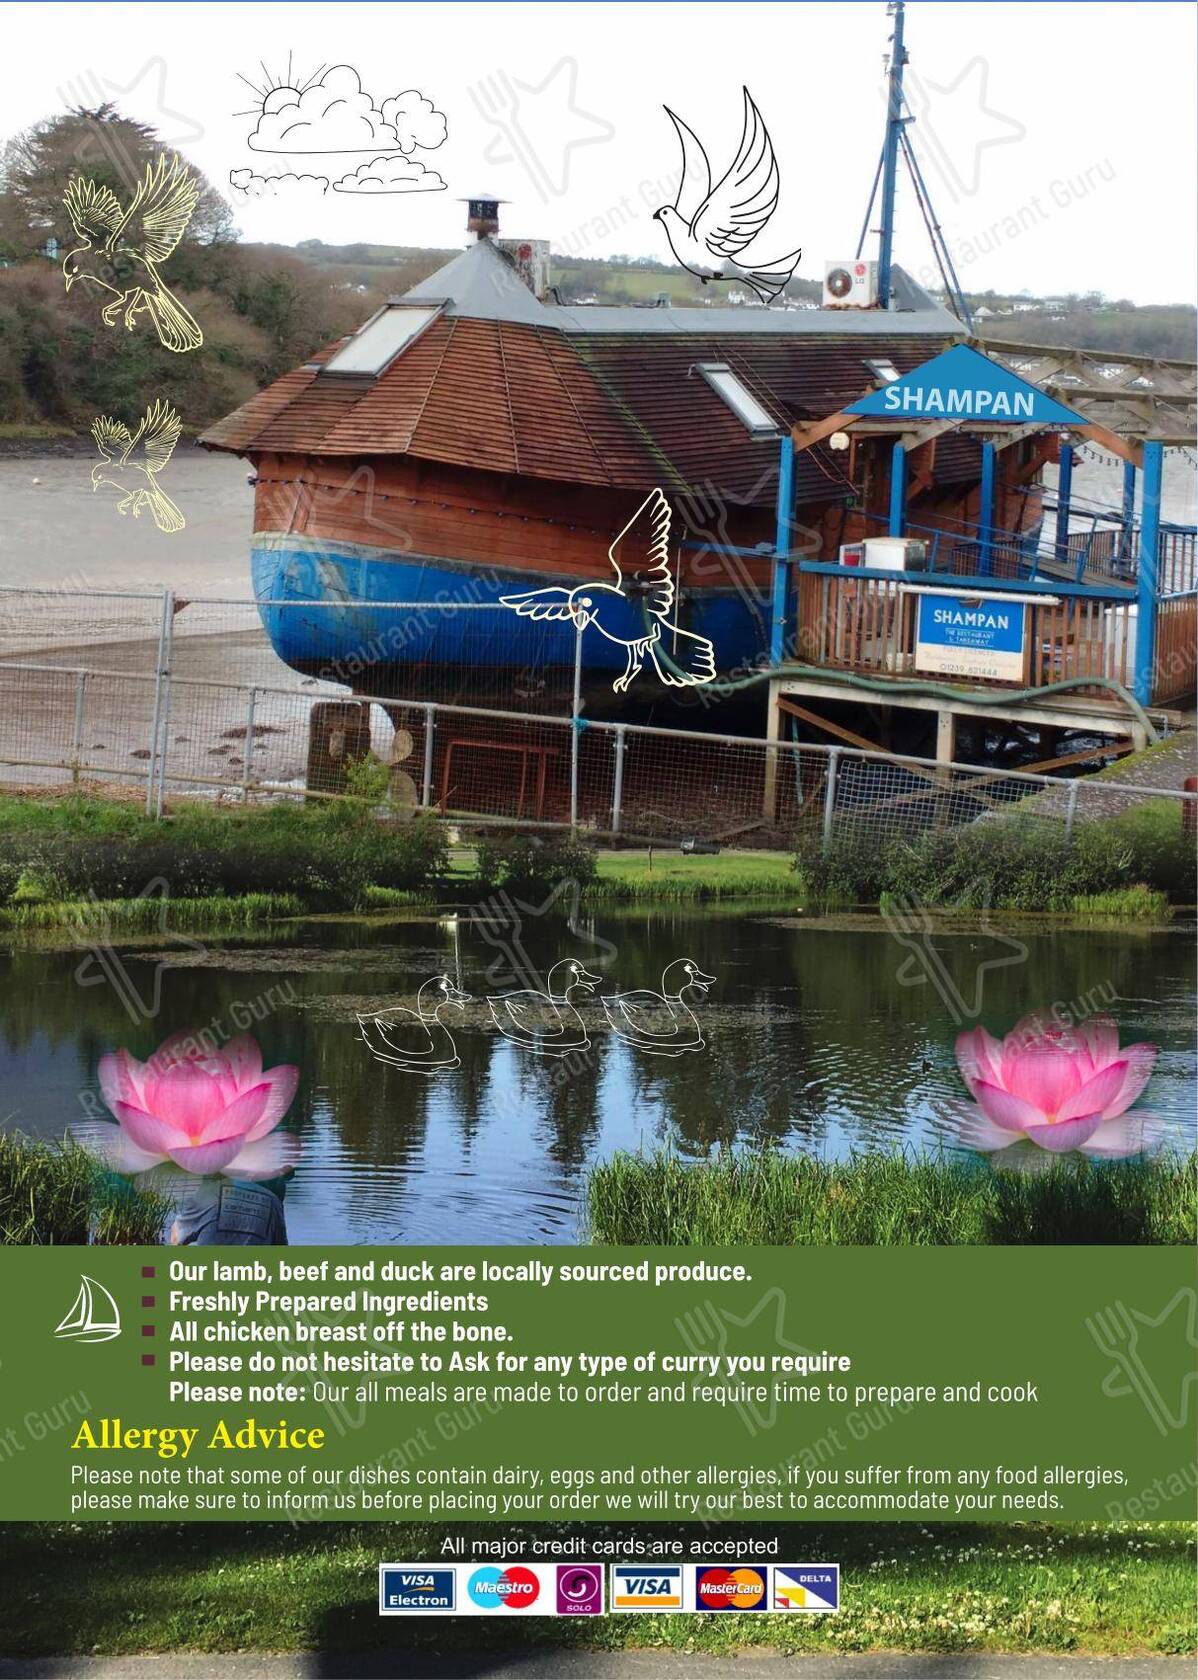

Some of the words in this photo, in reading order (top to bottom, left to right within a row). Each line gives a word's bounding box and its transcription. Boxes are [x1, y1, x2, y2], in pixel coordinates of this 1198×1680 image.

[885, 386, 1034, 417] SHAMPAN
[933, 609, 1009, 629] SHAMPAN
[169, 1260, 208, 1282] Our
[213, 1260, 273, 1284] lamb,
[279, 1260, 329, 1282] beef
[334, 1260, 375, 1281] and
[380, 1260, 435, 1281] duck
[440, 1265, 476, 1282] are
[482, 1260, 554, 1287] locally
[559, 1260, 649, 1282] sourced
[655, 1260, 752, 1286] produce.
[170, 1290, 250, 1317] Freshly
[256, 1290, 357, 1317] Prepared
[362, 1290, 489, 1317] Ingredients
[169, 1320, 198, 1342] All
[203, 1320, 290, 1342] chicken
[295, 1321, 367, 1342] breast
[373, 1320, 405, 1342] off
[410, 1321, 447, 1342] the
[452, 1321, 514, 1342] bone.
[170, 1351, 243, 1372] Please
[248, 1351, 276, 1372] do
[281, 1352, 318, 1372] not
[323, 1350, 415, 1372] hesitate
[420, 1352, 443, 1372] to
[448, 1351, 491, 1372] Ask
[495, 1351, 529, 1372] for
[533, 1356, 573, 1377] any
[578, 1352, 628, 1377] type
[633, 1351, 656, 1372] of
[662, 1356, 721, 1377] curry
[726, 1355, 765, 1377] you
[771, 1350, 851, 1377] require
[170, 1381, 243, 1402] Please
[249, 1382, 306, 1402] note:
[313, 1381, 350, 1402] Our
[355, 1381, 378, 1402] all
[385, 1381, 447, 1402] meals
[453, 1386, 487, 1402] are
[494, 1381, 551, 1402] made
[558, 1383, 579, 1402] to
[585, 1381, 642, 1402] order
[647, 1381, 685, 1402] and
[692, 1381, 767, 1407] require
[774, 1381, 821, 1402] time
[827, 1383, 848, 1402] to
[855, 1386, 936, 1407] prepare
[943, 1381, 981, 1402] and
[988, 1381, 1038, 1402] cook
[71, 1418, 199, 1459] Allergy
[207, 1418, 325, 1449] Advice
[71, 1465, 133, 1485] Please
[139, 1467, 181, 1485] note
[186, 1465, 225, 1485] that
[230, 1470, 282, 1485] some
[288, 1465, 307, 1485] of
[312, 1470, 344, 1485] our
[349, 1465, 410, 1485] dishes
[416, 1465, 487, 1485] contain
[492, 1465, 544, 1489] dairy,
[550, 1470, 595, 1489] eggs
[600, 1465, 634, 1484] and
[640, 1465, 692, 1485] other
[696, 1465, 781, 1489] allergies,
[788, 1465, 801, 1484] if
[805, 1470, 839, 1489] you
[844, 1465, 902, 1485] suffer
[906, 1465, 951, 1484] from
[957, 1470, 991, 1489] any
[995, 1465, 1037, 1485] food
[1043, 1465, 1128, 1489] allergies,
[71, 1490, 132, 1514] please
[138, 1490, 189, 1509] make
[195, 1494, 236, 1509] sure
[241, 1491, 261, 1509] to
[267, 1490, 328, 1509] inform
[334, 1494, 356, 1509] us
[362, 1489, 423, 1509] before
[429, 1490, 497, 1514] placing
[502, 1494, 544, 1514] your
[549, 1490, 601, 1509] order
[605, 1494, 632, 1509] we
[637, 1490, 668, 1509] will
[674, 1491, 700, 1514] try
[705, 1494, 737, 1509] our
[743, 1490, 784, 1509] best
[788, 1491, 808, 1509] to
[813, 1490, 949, 1509] accommodate
[954, 1494, 997, 1514] your
[1002, 1490, 1064, 1509] needs.
[441, 1537, 464, 1554] All
[472, 1537, 527, 1558] major
[532, 1537, 586, 1554] credit
[592, 1537, 646, 1554] cards
[652, 1541, 683, 1554] are
[690, 1537, 778, 1558] accepted
[401, 1574, 435, 1586] VISA
[475, 1581, 533, 1594] Maestro
[624, 1578, 671, 1595] VISA
[700, 1582, 763, 1595] MasterCard
[389, 1595, 448, 1606] Electron
